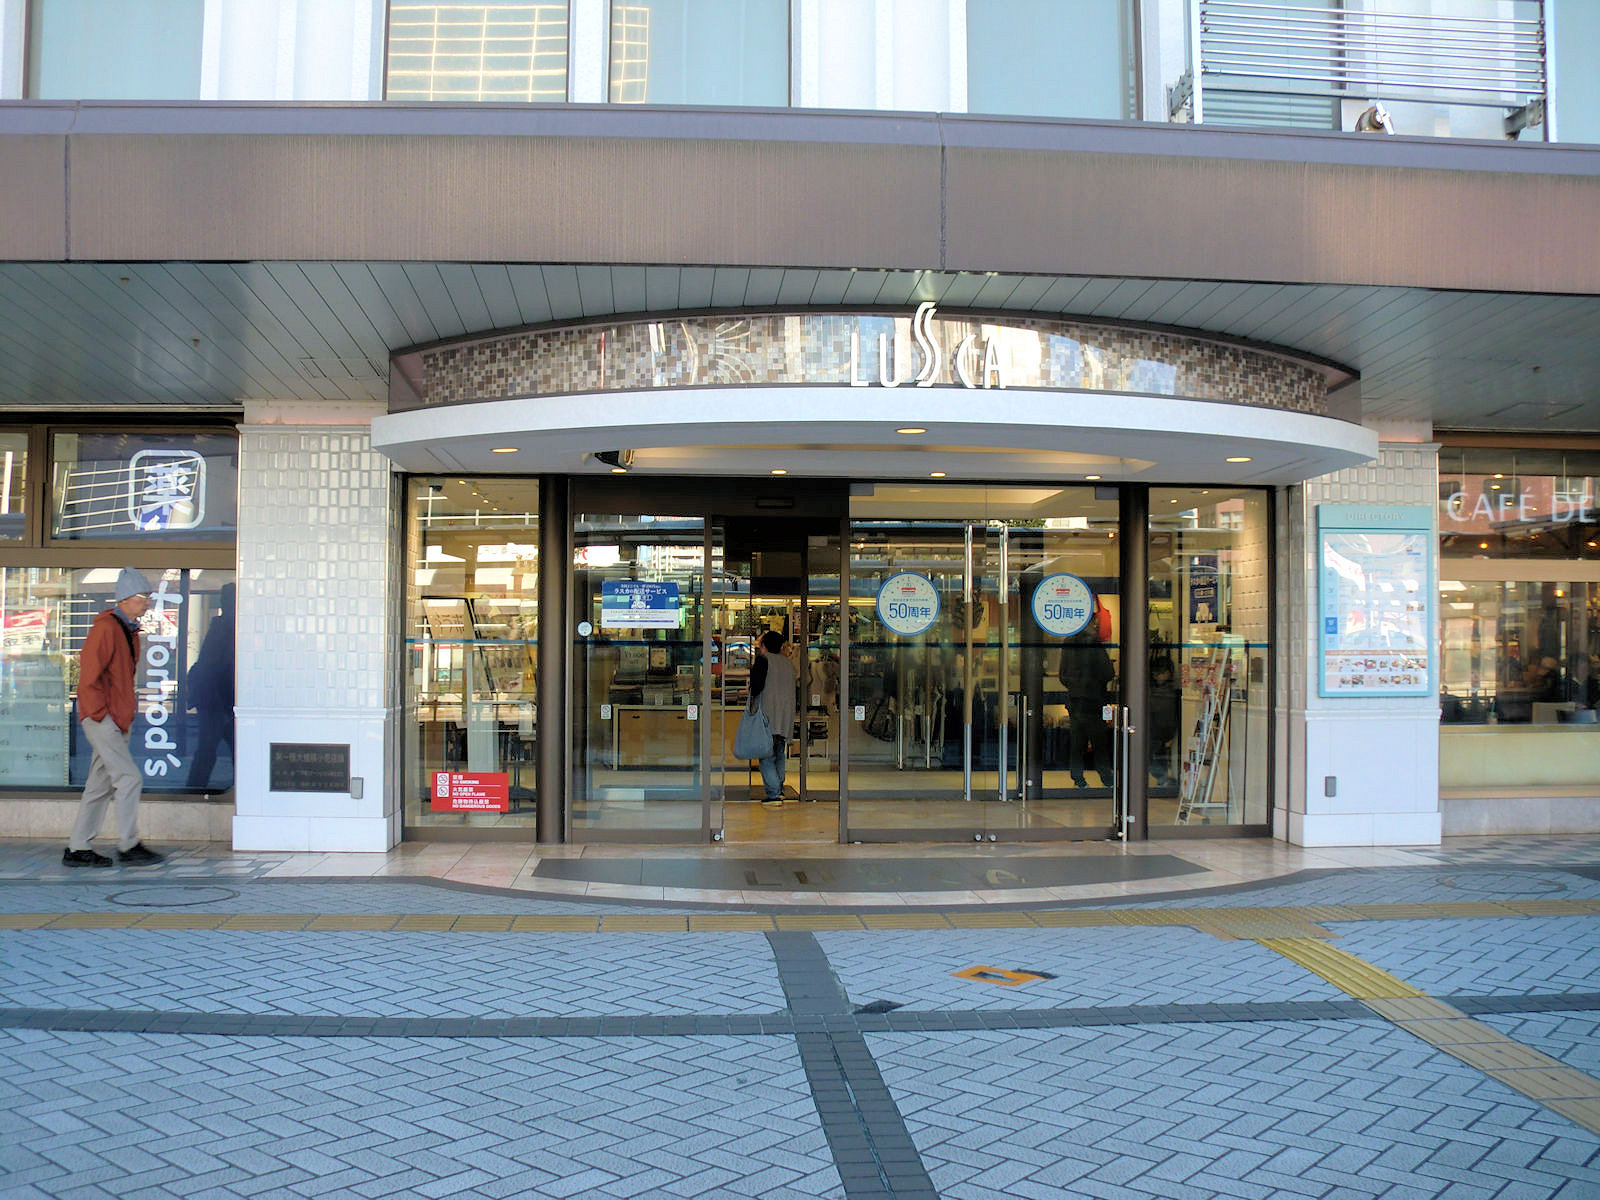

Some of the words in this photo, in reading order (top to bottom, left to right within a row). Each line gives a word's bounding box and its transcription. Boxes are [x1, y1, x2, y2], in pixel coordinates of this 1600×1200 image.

[850, 301, 1007, 389] LUSCA
[1447, 486, 1537, 522] CAFÉ
[1551, 494, 1597, 523] DE
[889, 602, 931, 618] 50周年
[1044, 604, 1085, 619] 50周年
[144, 629, 182, 777] Tomod's
